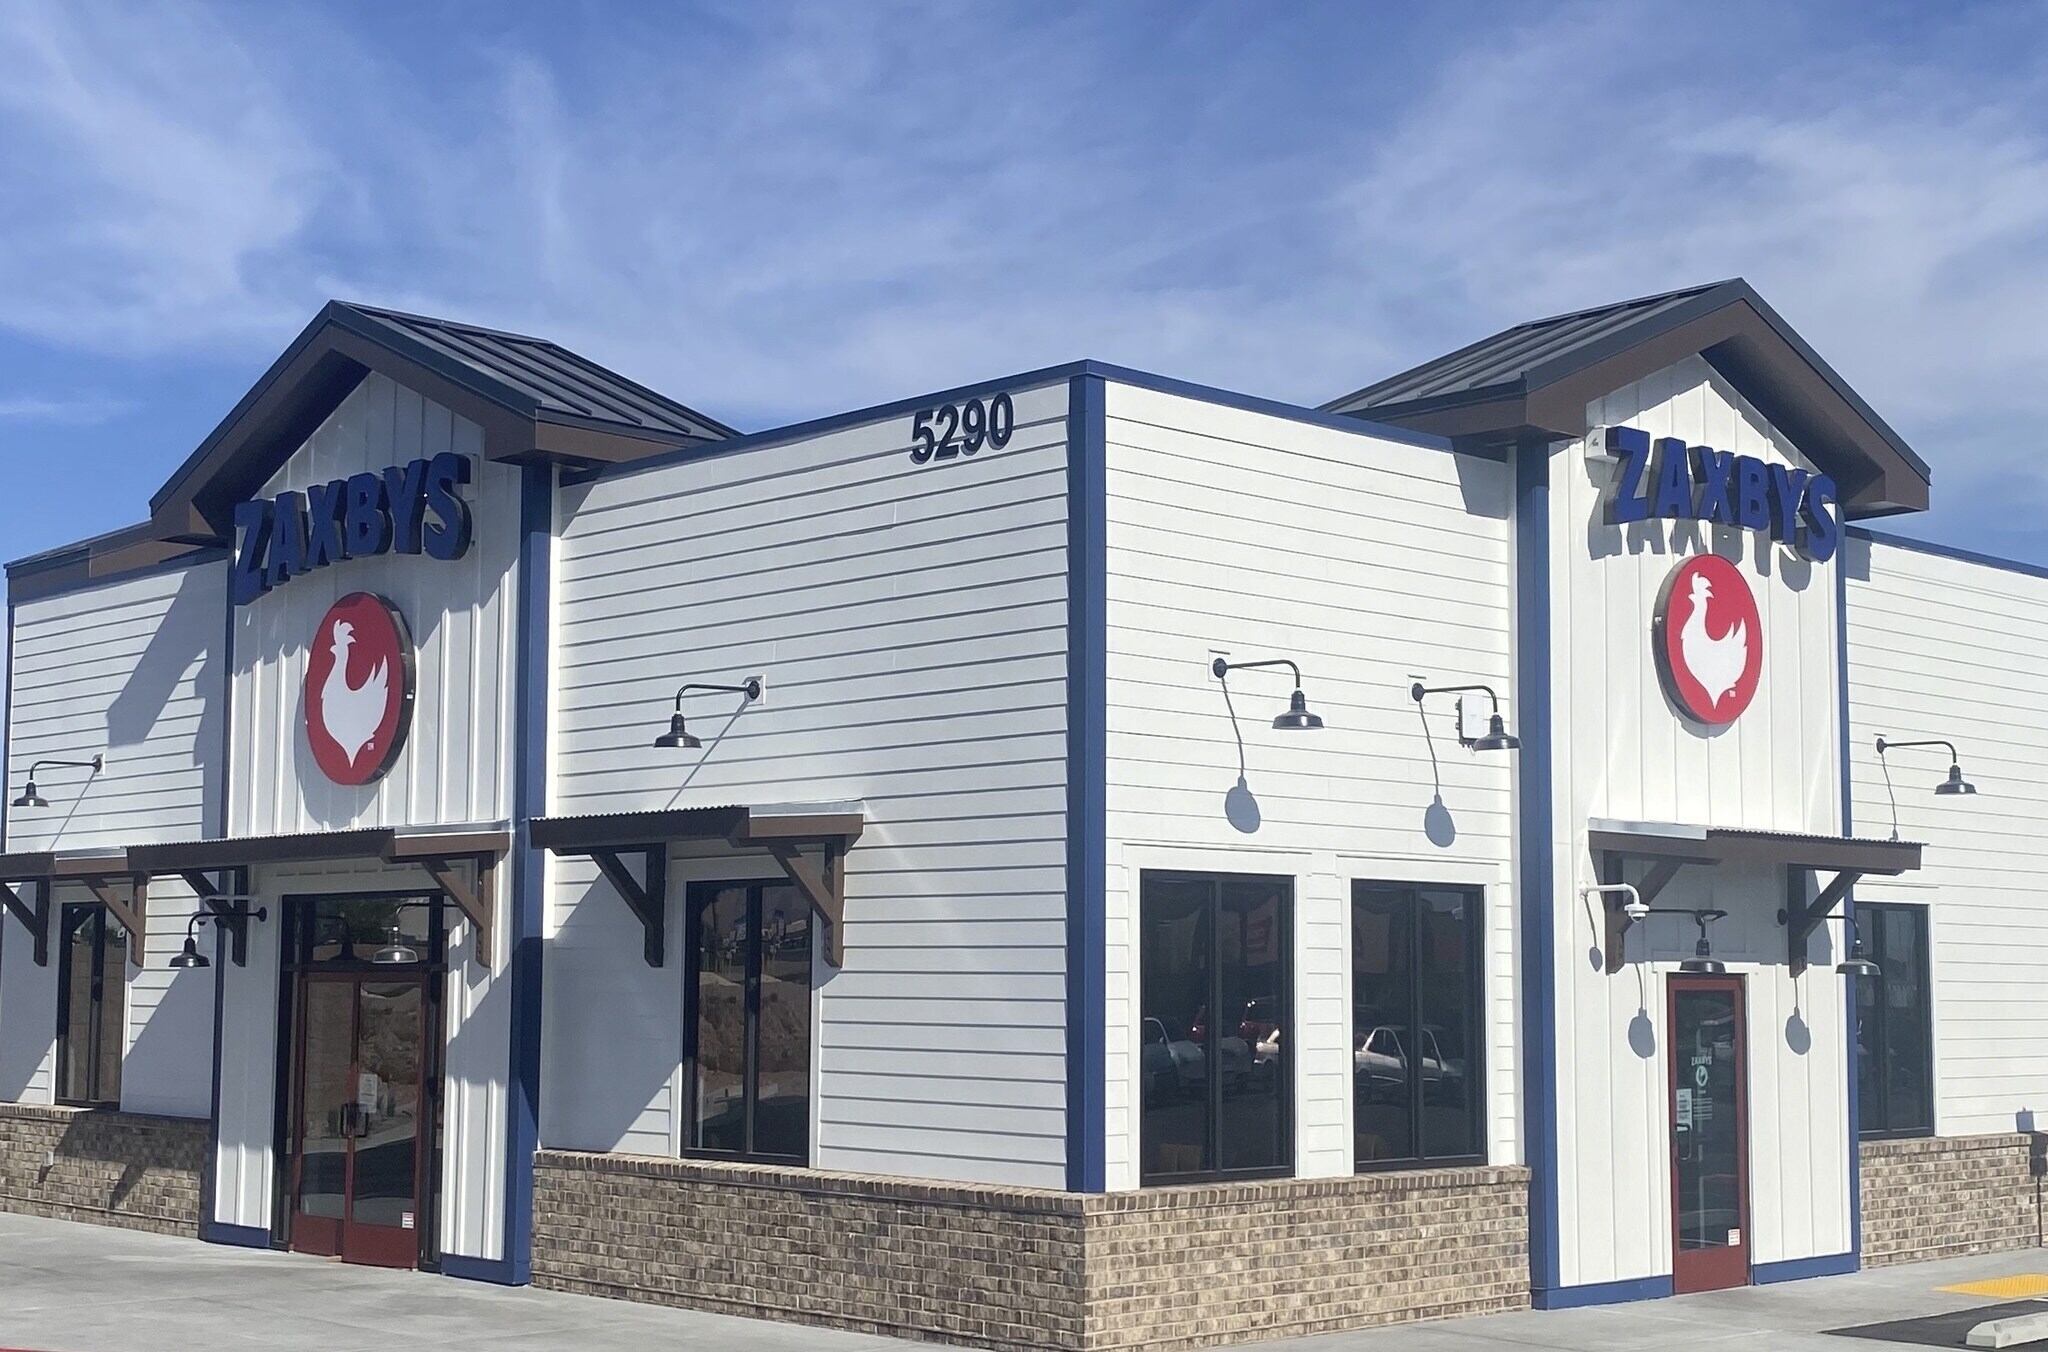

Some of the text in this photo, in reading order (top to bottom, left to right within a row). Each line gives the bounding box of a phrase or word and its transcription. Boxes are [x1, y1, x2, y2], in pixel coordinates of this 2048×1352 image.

[911, 392, 1013, 464] 5290
[1603, 425, 1836, 564] ZAXBYS
[233, 452, 472, 606] ZAXBYS
